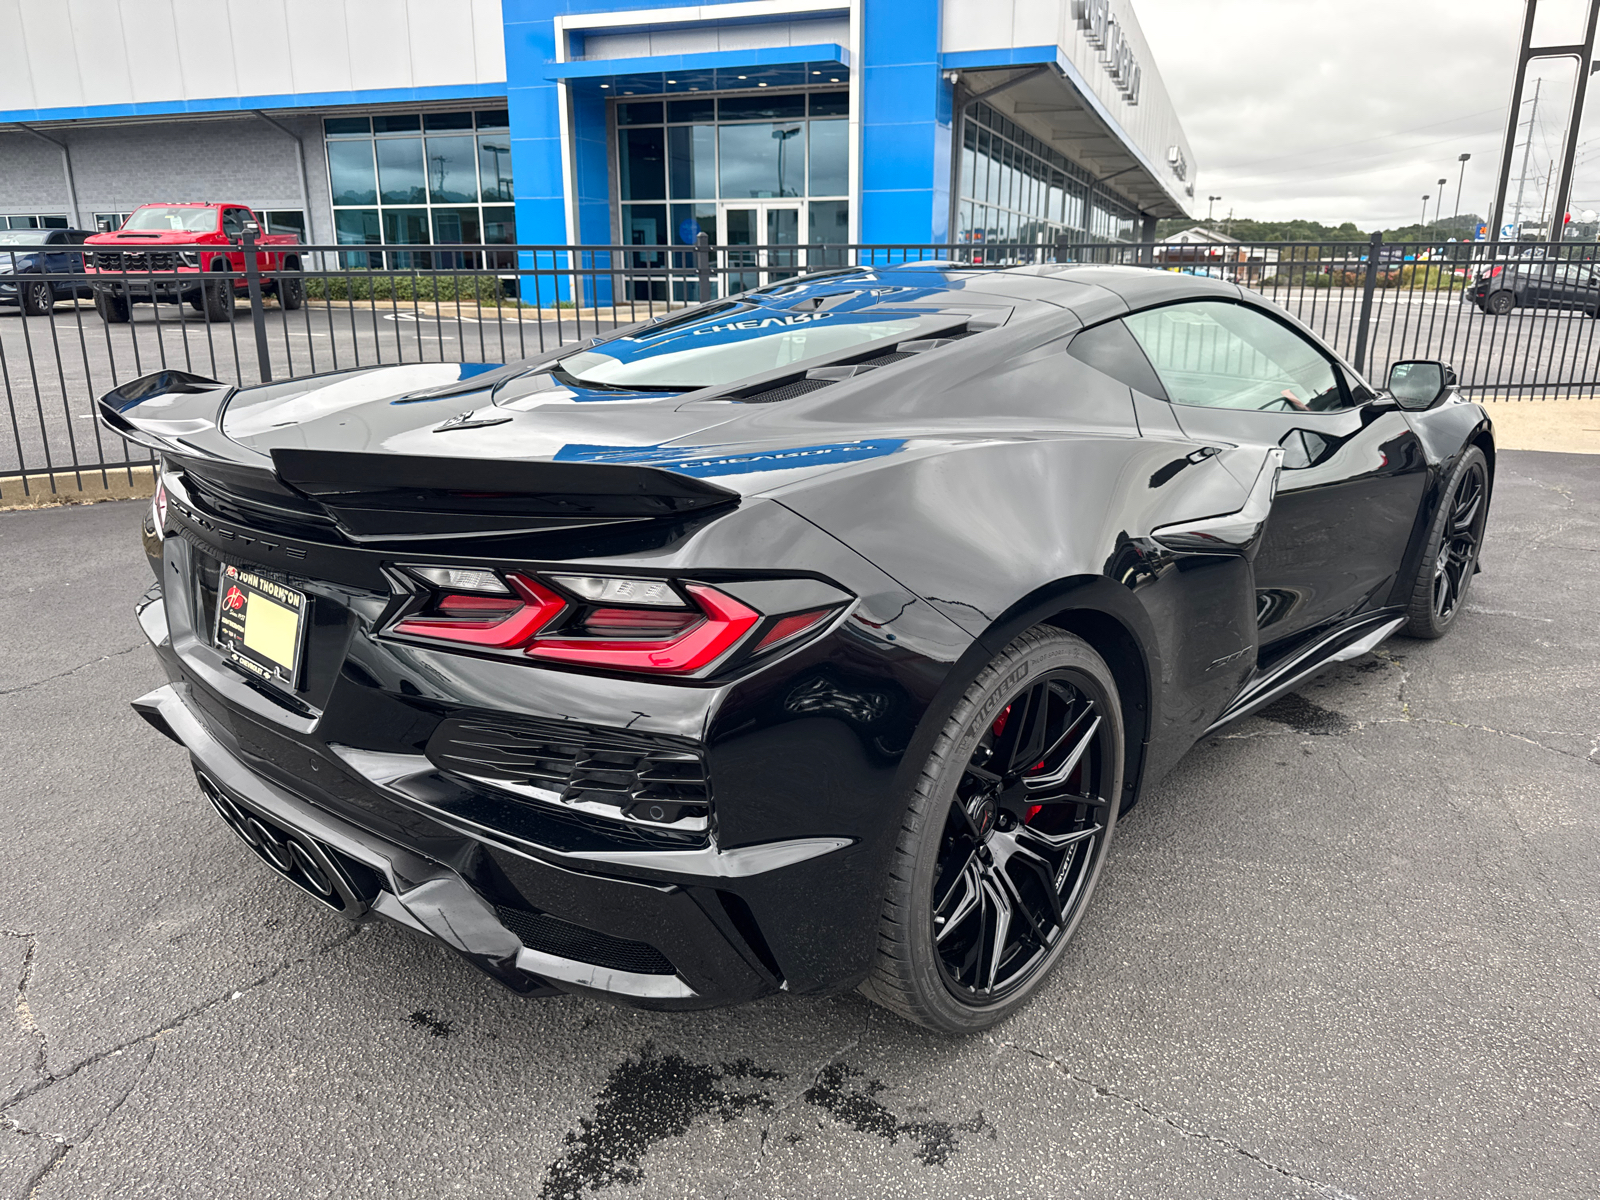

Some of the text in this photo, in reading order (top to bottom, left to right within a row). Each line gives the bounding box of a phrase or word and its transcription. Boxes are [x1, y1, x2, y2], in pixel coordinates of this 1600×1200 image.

[239, 571, 258, 589] JOHN
[259, 578, 300, 607] THORNTON
[239, 657, 264, 676] CHEVROLET
[971, 660, 1029, 733] MICHELIN
